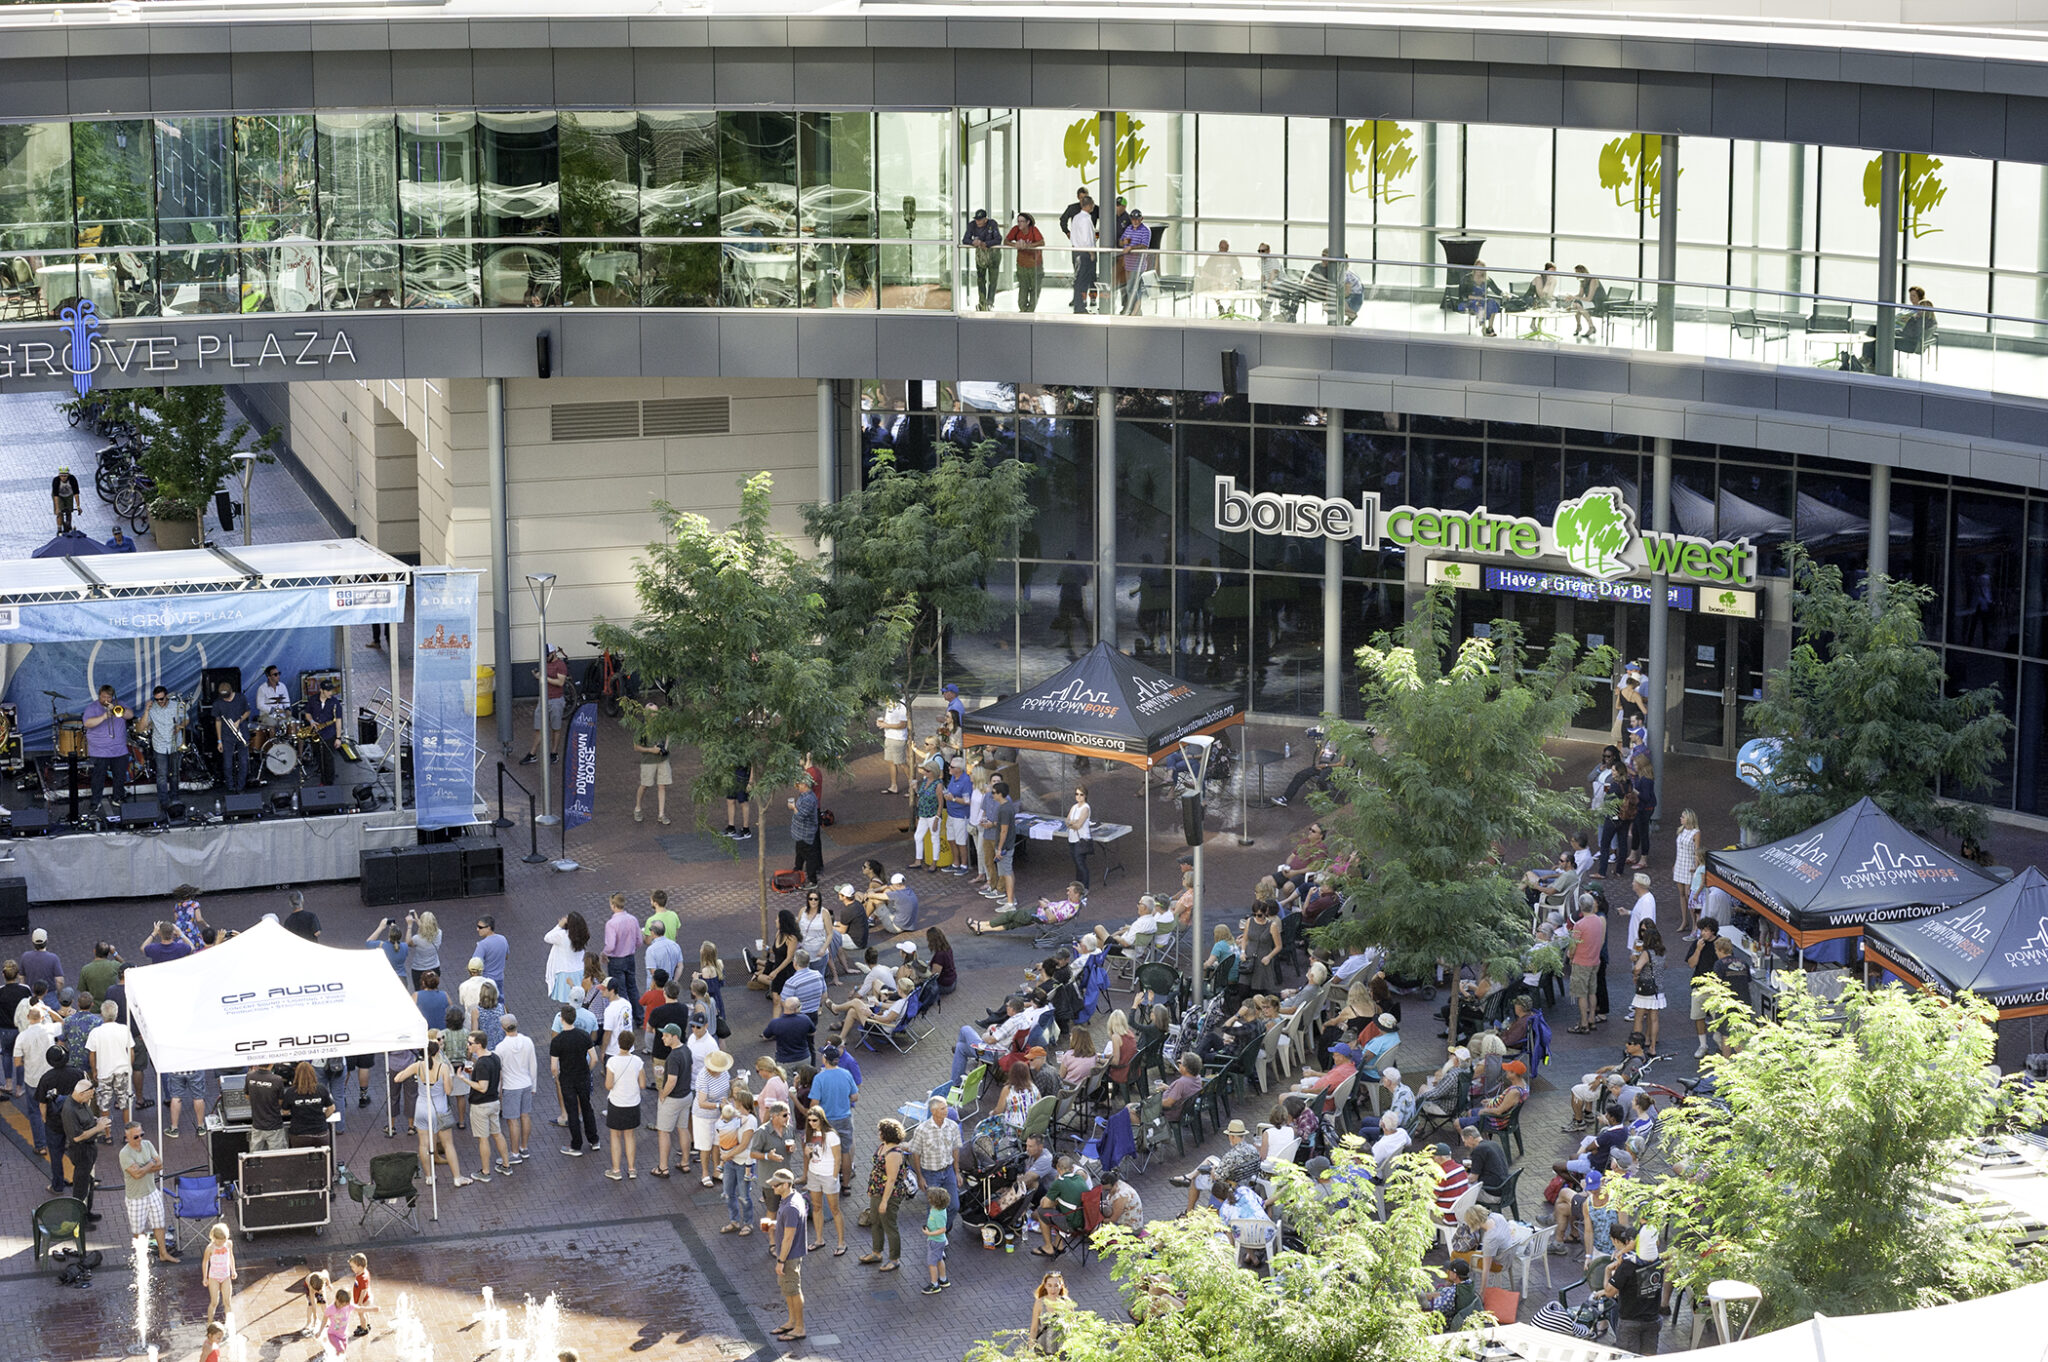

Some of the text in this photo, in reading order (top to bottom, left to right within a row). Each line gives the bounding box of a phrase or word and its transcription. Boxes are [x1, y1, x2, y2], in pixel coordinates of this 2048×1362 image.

[197, 330, 357, 369] PLAZA
[1217, 480, 1749, 585] boise centre west
[1500, 571, 1536, 587] Have
[1540, 578, 1548, 588] a
[1553, 577, 1596, 593] Great
[1600, 581, 1629, 599] Day
[432, 596, 472, 605] DELTA
[109, 609, 243, 628] THE GROVE PLAZA
[1020, 705, 1114, 719] ASSOCIATION
[1159, 704, 1235, 746] www.downtownboise.org
[983, 724, 1126, 752] www.downtownboise.org
[576, 733, 588, 795] DOWNTOWN
[585, 746, 596, 785] BOISE
[1759, 853, 1812, 884] ASSOCIATION
[1715, 864, 1791, 923] www.downtownboise.org
[1846, 877, 1960, 890] ASSOCIATION
[1917, 926, 1974, 962] ASSOCIATION
[221, 982, 344, 1004] CP AUDIO
[235, 1033, 350, 1052] CP AUDIO
